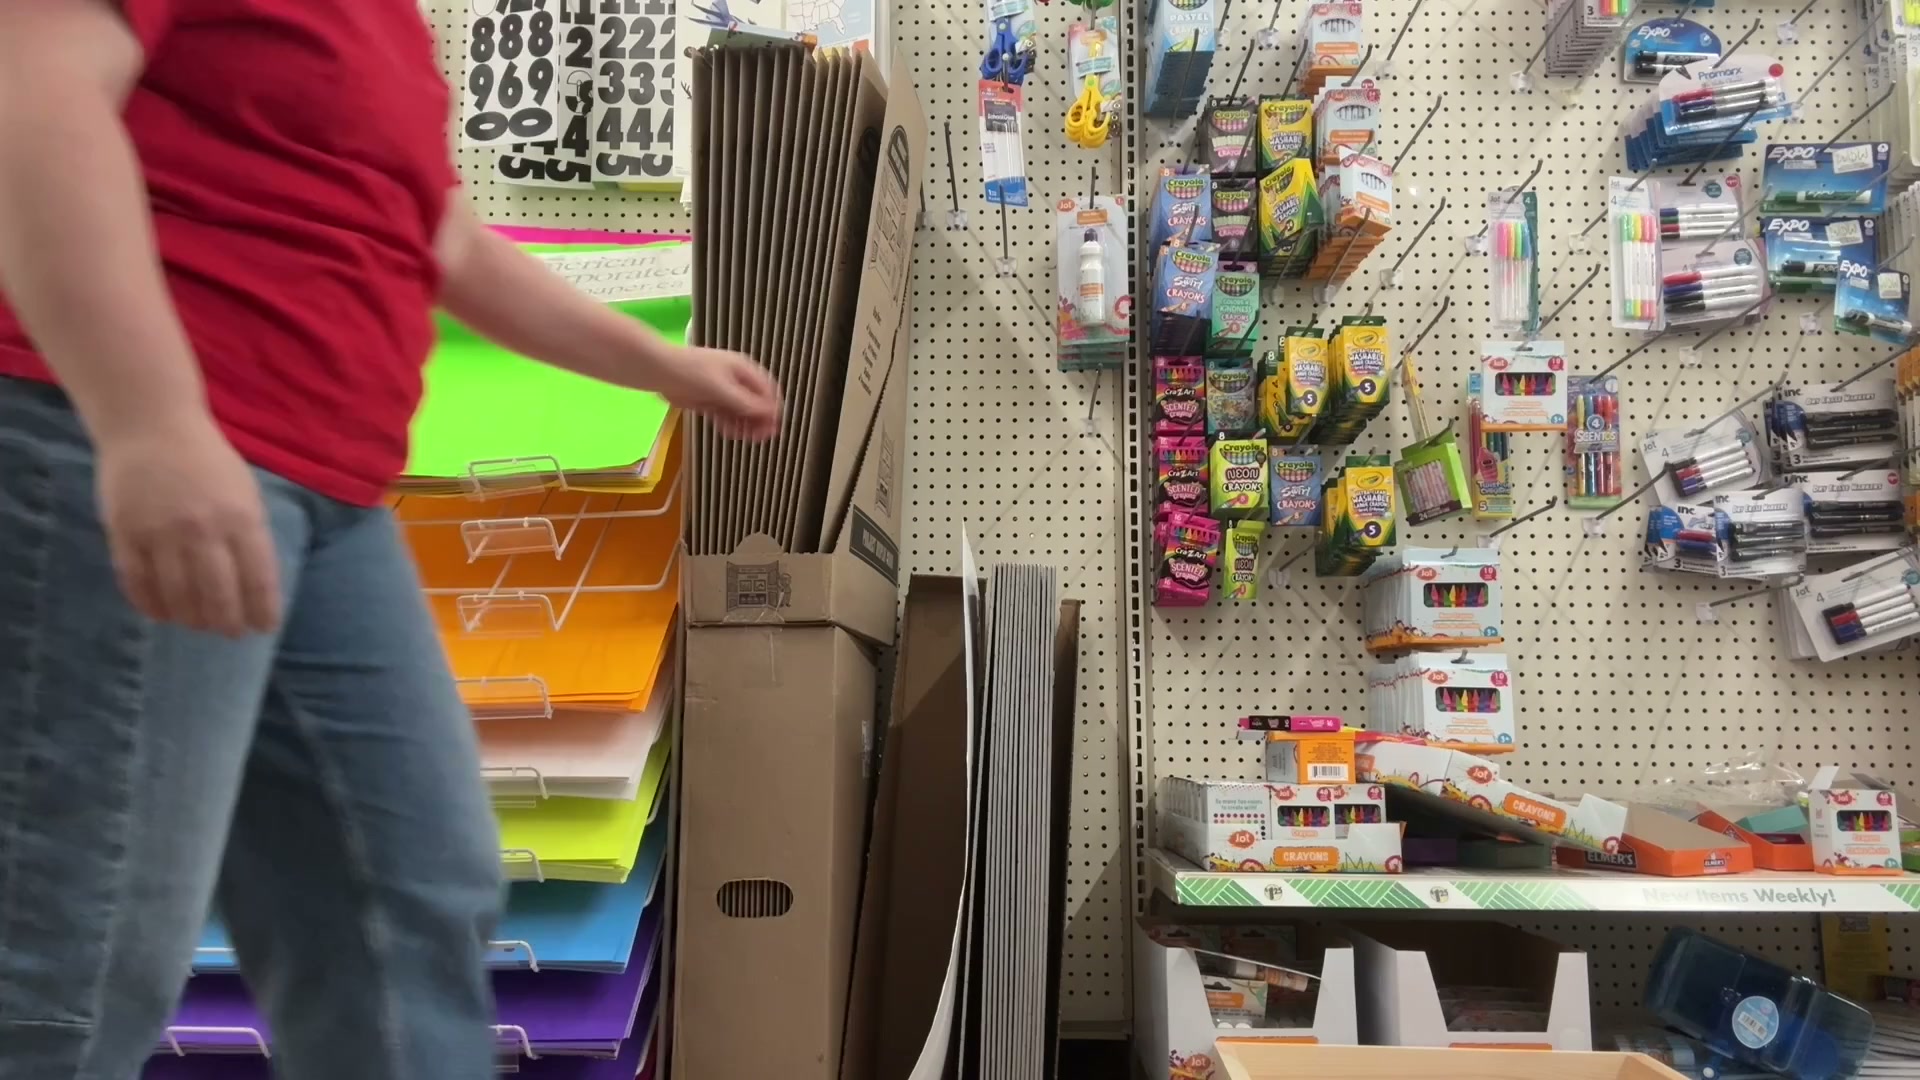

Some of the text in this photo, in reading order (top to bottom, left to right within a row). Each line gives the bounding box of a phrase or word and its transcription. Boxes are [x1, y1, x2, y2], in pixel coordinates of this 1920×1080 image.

[1587, 6, 1594, 15] 3
[1170, 13, 1209, 21] PASTEL
[1638, 26, 1671, 39] EXPO
[1698, 67, 1742, 80] Promarx
[1268, 103, 1304, 112] Crayola
[1214, 110, 1250, 119] Crayola
[1768, 147, 1816, 164] EXPO
[1265, 166, 1291, 186] Crayola
[1168, 179, 1204, 188] Crayola
[1214, 190, 1250, 200] Crayola
[1611, 195, 1617, 205] 4
[1059, 201, 1073, 210] Jot
[1768, 218, 1809, 235] EXPO
[1176, 250, 1211, 264] Crayola
[1839, 260, 1867, 277] EXPO
[1220, 276, 1252, 285] Crayola
[1167, 289, 1205, 303] CRAYONS
[1221, 313, 1249, 321] CRAYONS
[1268, 351, 1274, 360] 8
[1212, 373, 1248, 382] Crayola
[1365, 383, 1371, 392] 5
[1308, 394, 1313, 403] 5
[1164, 401, 1197, 413] SCENTED
[1592, 419, 1600, 428] 4
[1219, 432, 1225, 440] 8
[1576, 430, 1616, 442] SCENTOS
[1223, 444, 1260, 452] Crayola
[1643, 441, 1657, 451] Jot
[1272, 448, 1277, 456] 8
[1662, 448, 1669, 457] 4
[1793, 454, 1801, 464] 3
[1277, 461, 1314, 470] Crayola
[1226, 468, 1259, 480] NEON
[1167, 483, 1200, 495] SCENTED
[1223, 482, 1262, 492] CRAYONS
[1352, 494, 1390, 502] WASHABLE
[1277, 500, 1316, 510] CRAYONS
[1480, 501, 1487, 511] 5
[1369, 526, 1375, 535] 5
[1236, 534, 1256, 543] Crayola
[1674, 558, 1681, 568] 3
[1171, 562, 1205, 577] SCENTED
[1720, 565, 1727, 576] 3
[1795, 586, 1810, 597] Jot
[1816, 592, 1825, 603] 4
[1473, 768, 1488, 780] Jot
[1512, 799, 1557, 821] CRAYONS
[1235, 833, 1250, 843] Jot
[1283, 851, 1329, 862] CRAYONS
[1587, 850, 1634, 866] ELMER'S
[1642, 887, 1836, 907] New Items Weekly!
[1192, 1058, 1206, 1067] Jot
